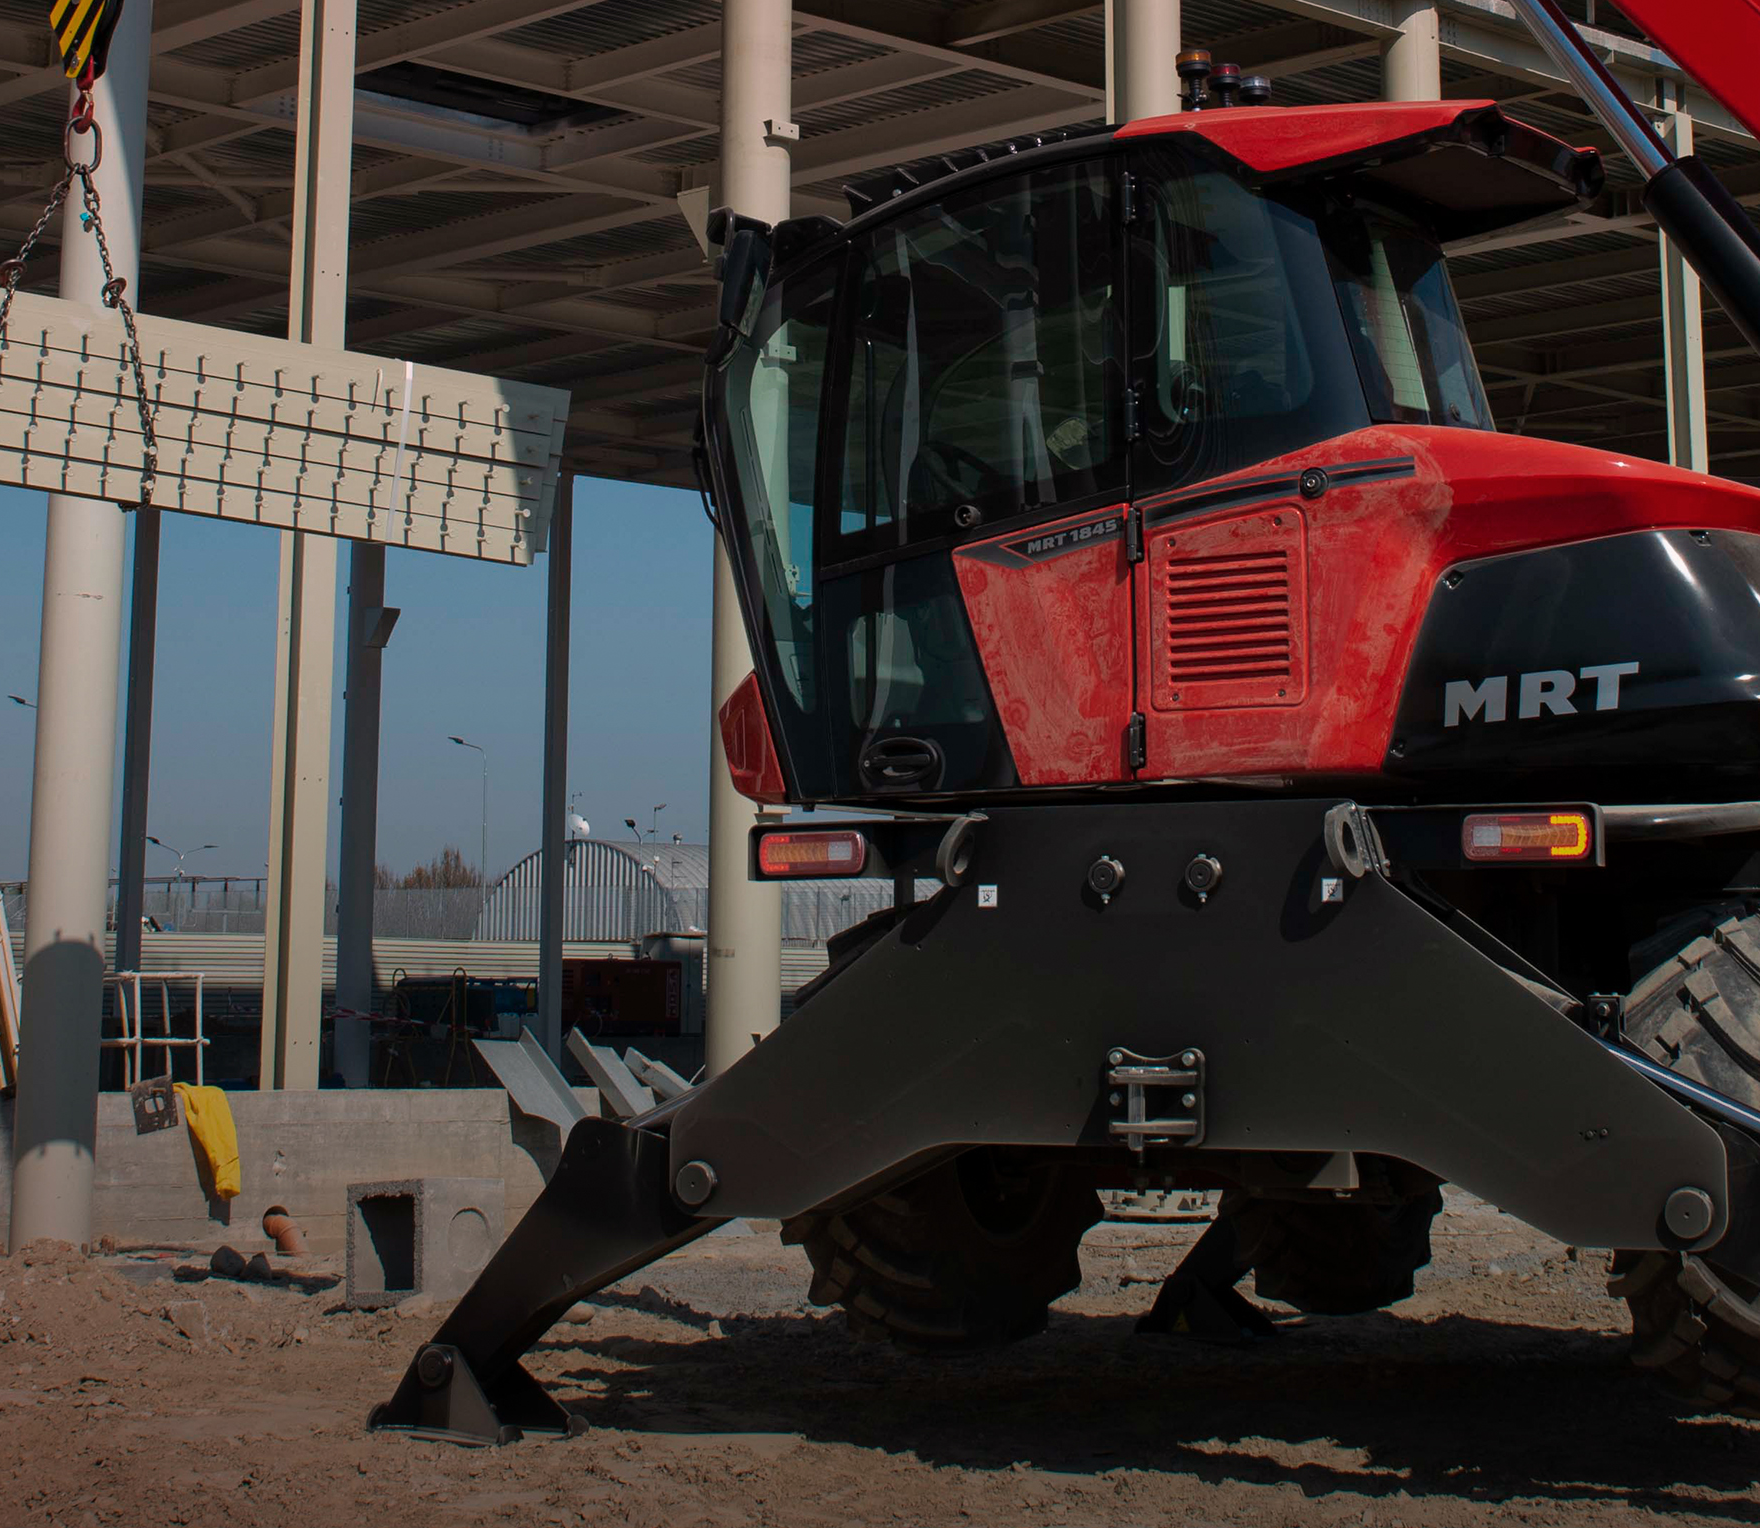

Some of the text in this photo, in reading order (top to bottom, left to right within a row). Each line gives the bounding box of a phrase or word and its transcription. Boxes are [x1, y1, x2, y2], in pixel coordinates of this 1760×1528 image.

[1027, 519, 1118, 554] MRT 1845
[1443, 660, 1640, 728] MRT
